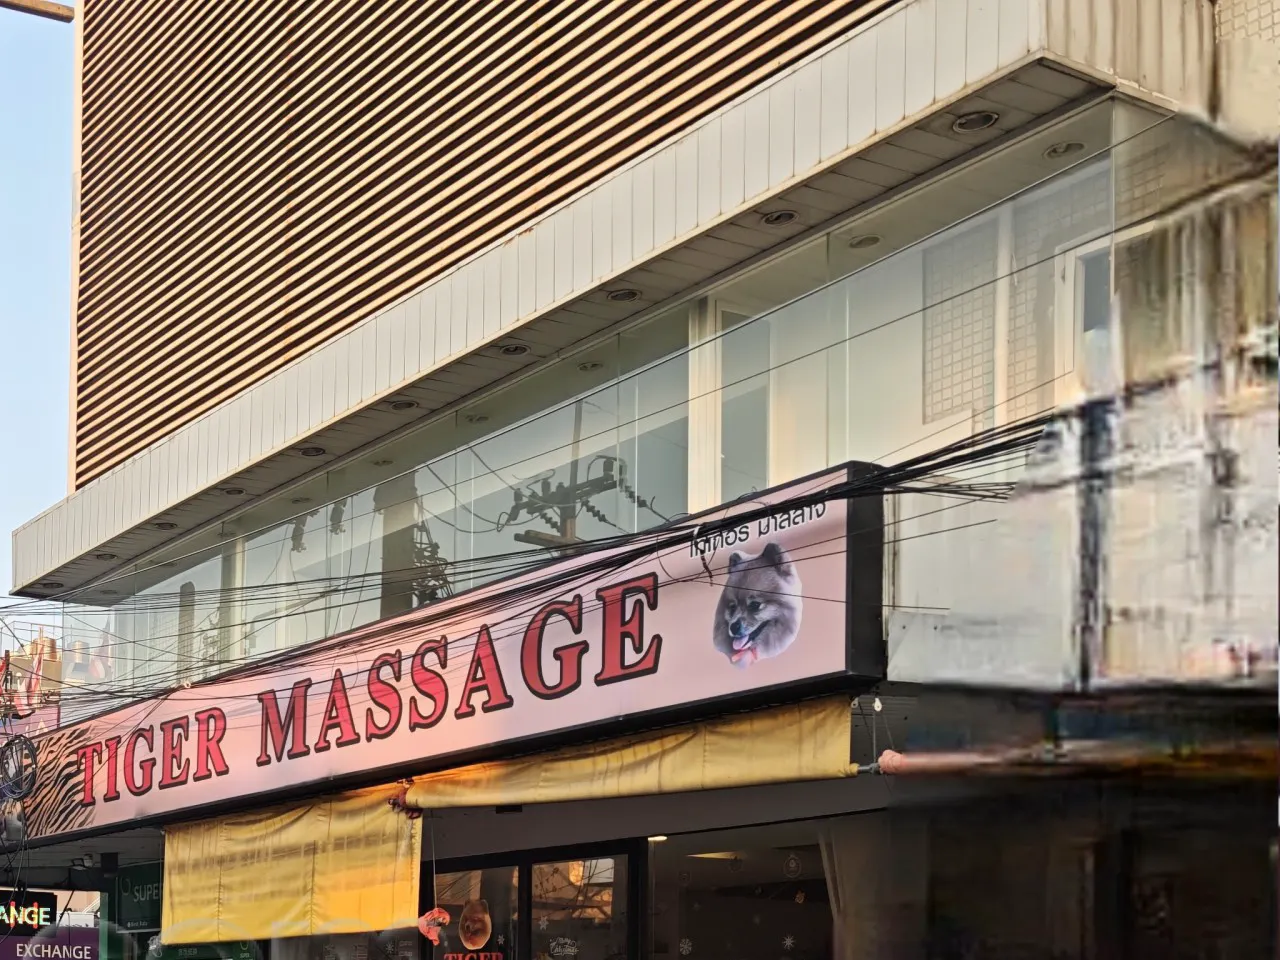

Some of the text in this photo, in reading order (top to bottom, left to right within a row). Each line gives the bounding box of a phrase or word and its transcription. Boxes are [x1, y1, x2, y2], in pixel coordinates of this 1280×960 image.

[76, 571, 664, 808] TIGER MASSAGE
[133, 883, 161, 902] SUPE
[16, 943, 92, 960] EXCHANGE
